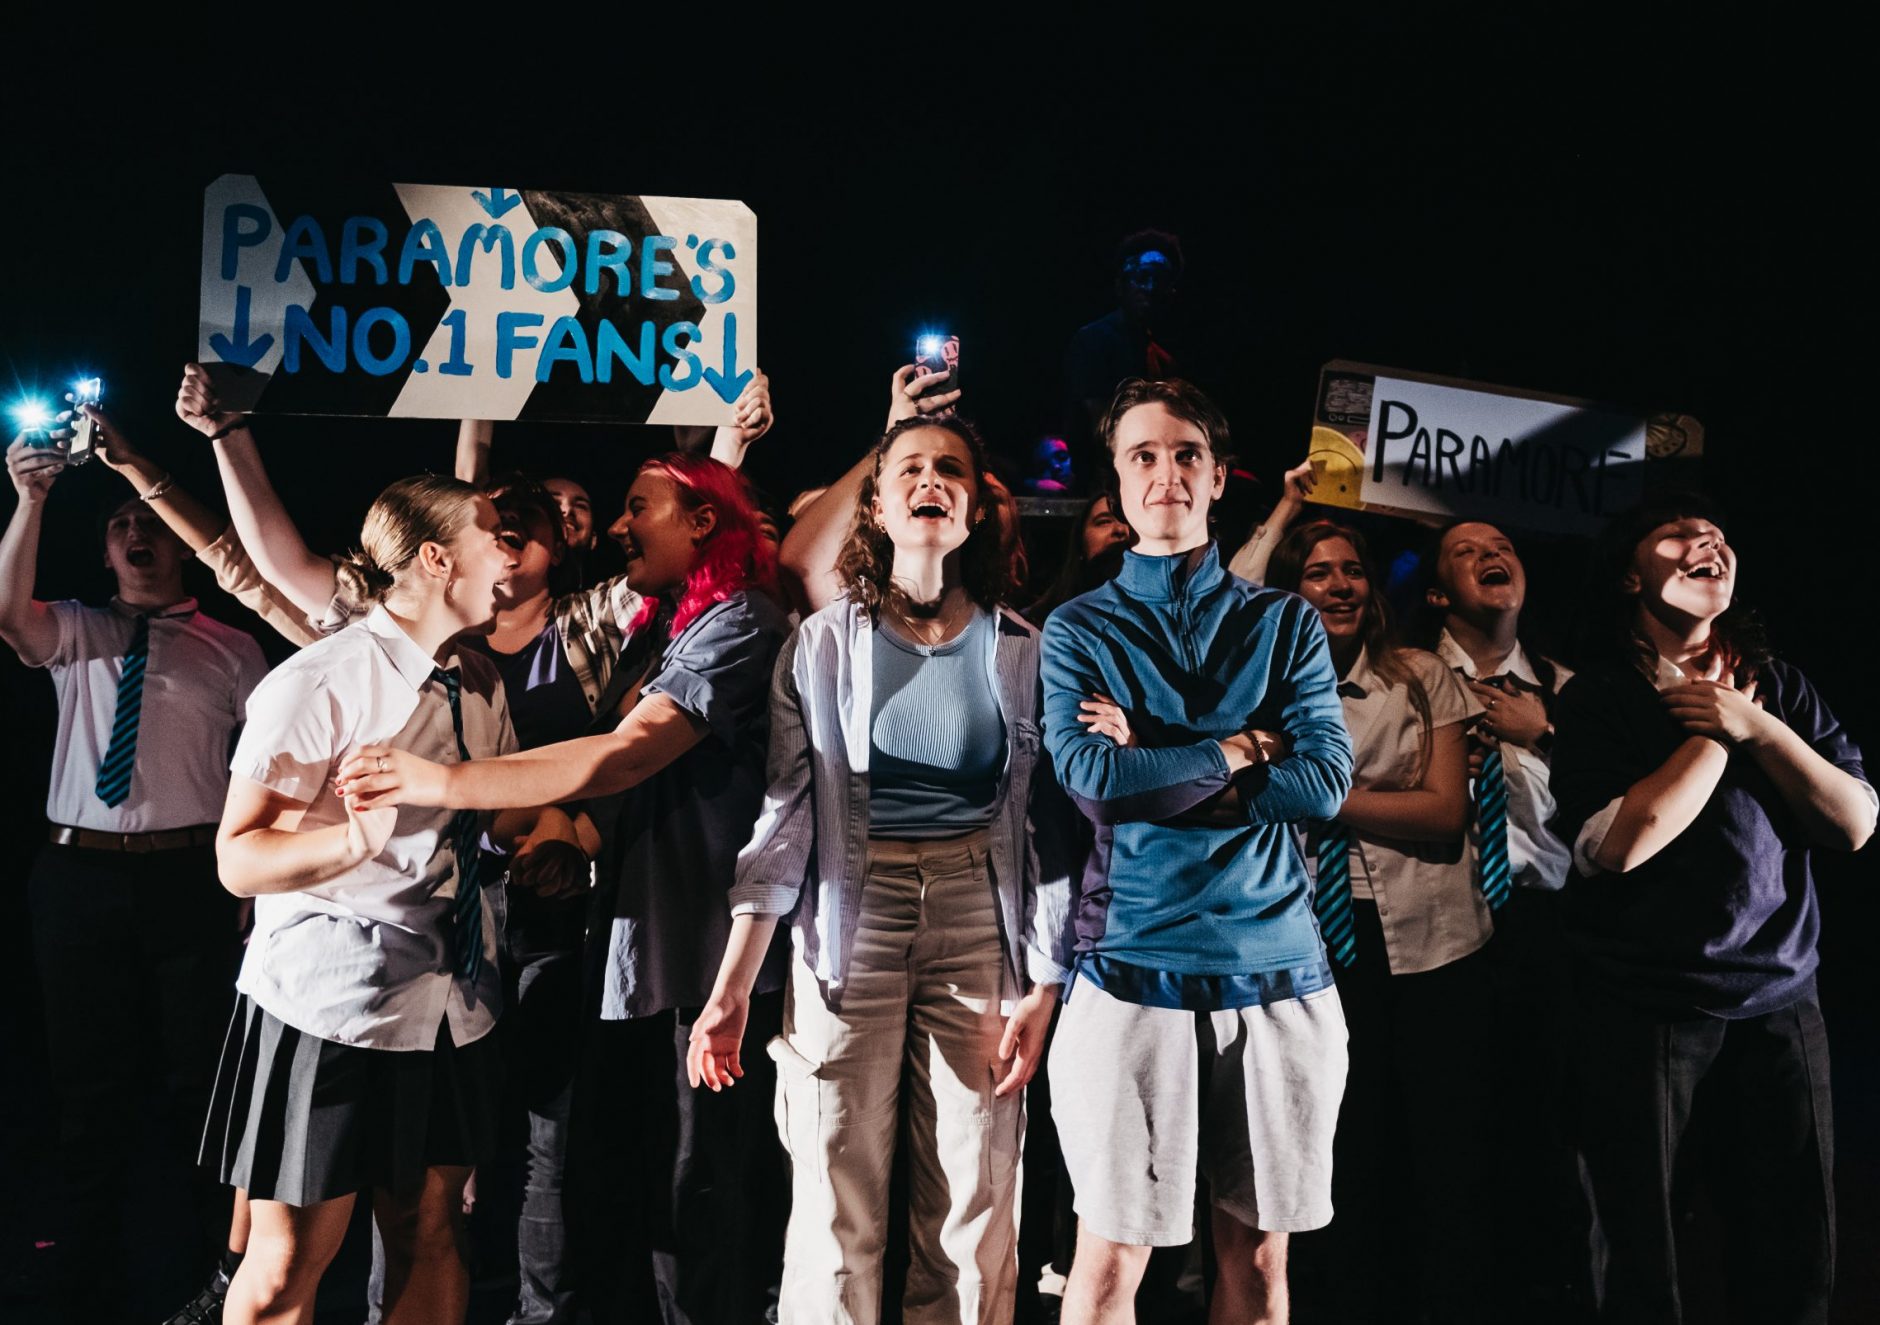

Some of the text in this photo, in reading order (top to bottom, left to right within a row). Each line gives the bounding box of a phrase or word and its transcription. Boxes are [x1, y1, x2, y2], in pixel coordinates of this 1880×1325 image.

[221, 203, 736, 304] PARAMORE'S
[496, 311, 702, 392] FANS
[1372, 400, 1632, 518] PARAMORE
